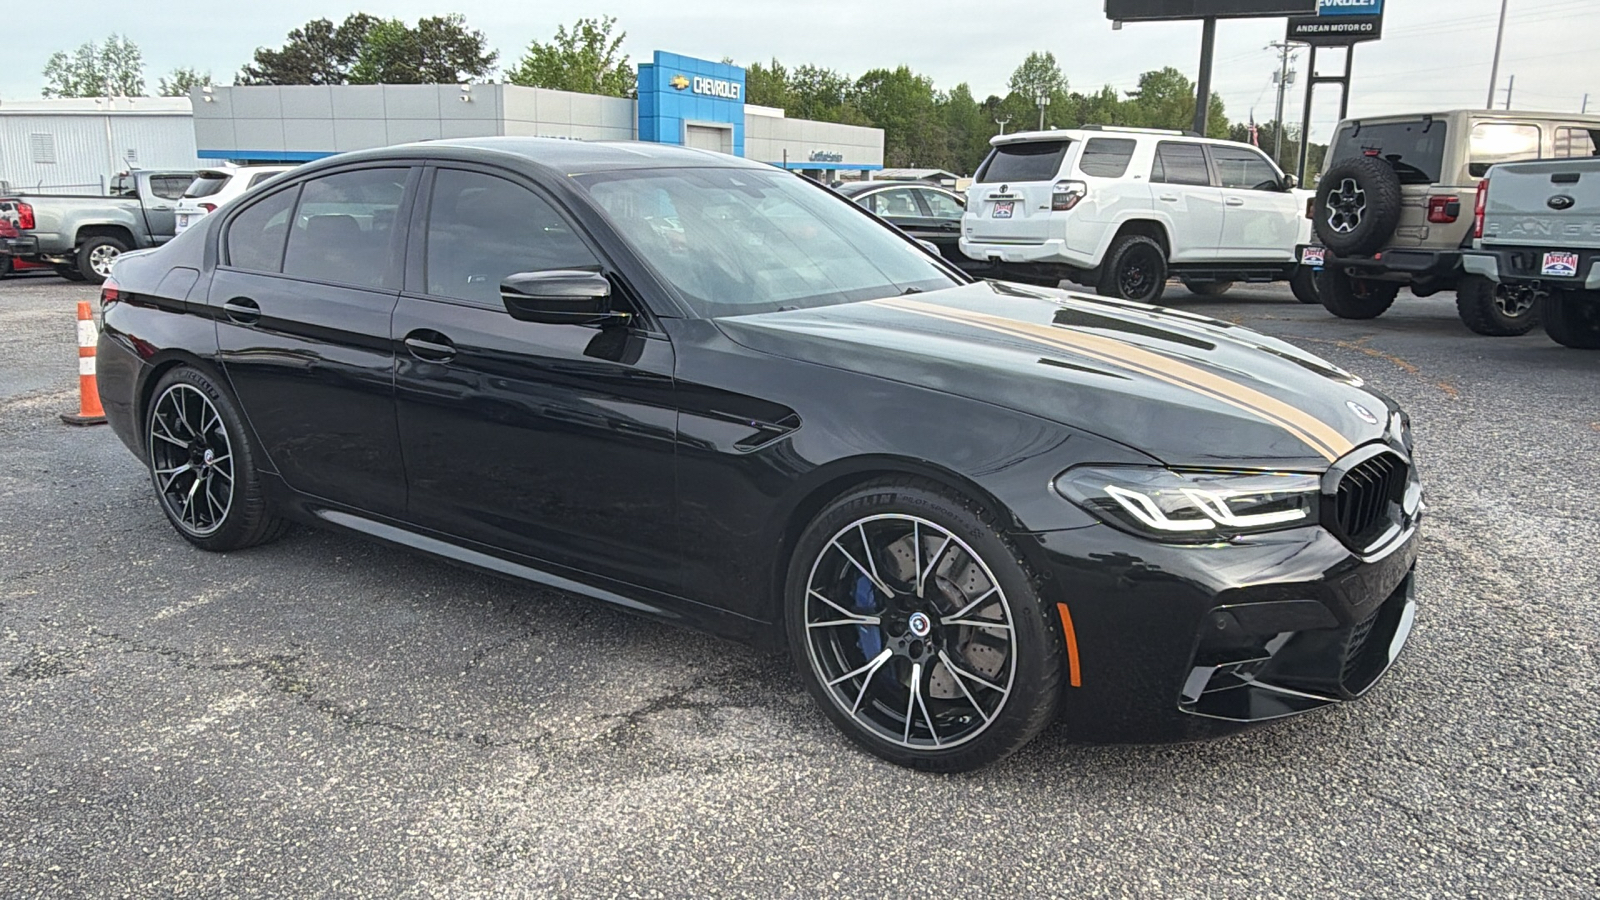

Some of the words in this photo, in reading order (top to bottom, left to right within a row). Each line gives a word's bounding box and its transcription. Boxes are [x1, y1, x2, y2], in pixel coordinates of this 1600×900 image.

[1331, 23, 1359, 31] MOTOR
[1361, 23, 1372, 31] CO
[693, 76, 741, 99] CHEVROLET
[1544, 254, 1577, 269] ANDEAN
